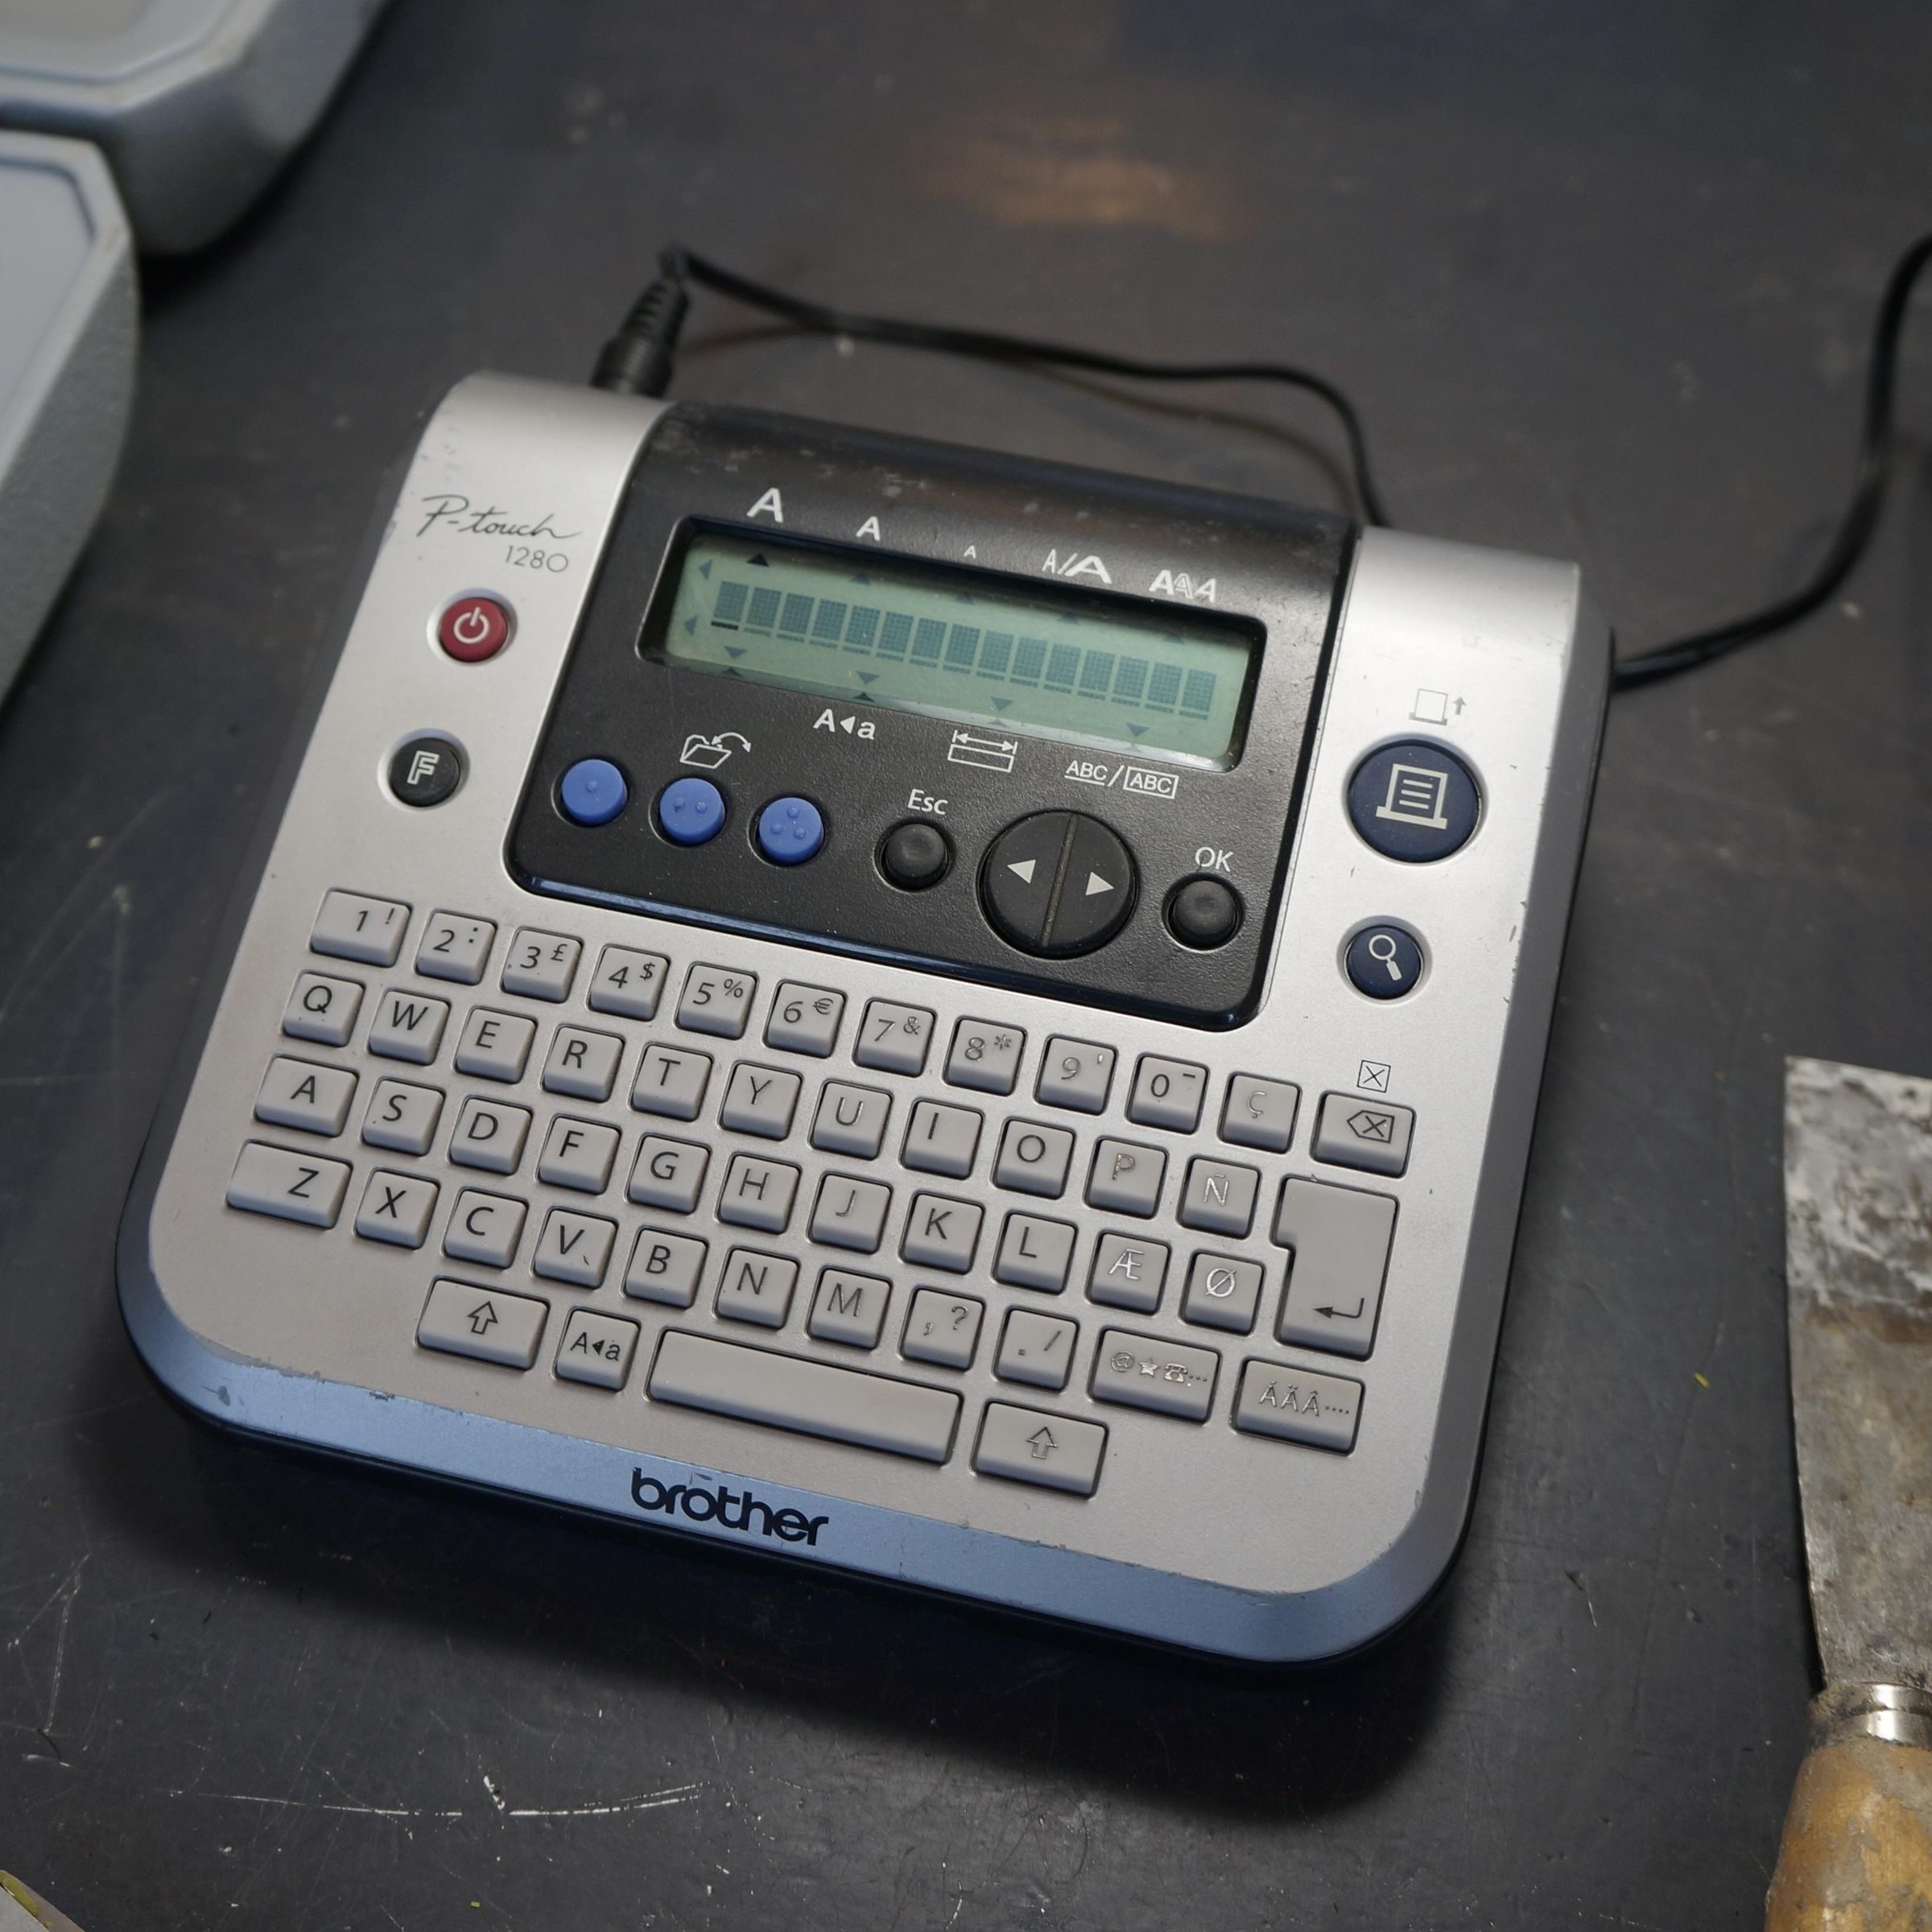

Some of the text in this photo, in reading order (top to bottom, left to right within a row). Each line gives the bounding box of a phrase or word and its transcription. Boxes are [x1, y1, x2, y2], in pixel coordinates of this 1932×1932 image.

[416, 494, 582, 539] P-touch
[746, 487, 784, 523] A
[856, 516, 881, 541] A
[506, 545, 568, 572] 1280
[964, 545, 976, 559] A
[407, 750, 440, 785] F
[907, 788, 948, 815] Esc
[1195, 846, 1234, 872] OK
[303, 985, 332, 1014] Q
[391, 1000, 429, 1031] W
[475, 1020, 501, 1049] E
[563, 1039, 588, 1069] R
[658, 1057, 681, 1087] T
[290, 1075, 316, 1104] A
[749, 1075, 773, 1105] Y
[382, 1094, 407, 1122] S
[836, 1096, 864, 1126] U
[1248, 1091, 1268, 1119] Ç
[467, 1112, 499, 1141] D
[927, 1112, 939, 1141] I
[559, 1129, 584, 1158] F
[1017, 1134, 1046, 1163] O
[650, 1151, 679, 1181] G
[1113, 1153, 1136, 1181] P
[287, 1167, 320, 1199] Z
[738, 1168, 770, 1201] H
[1203, 1172, 1230, 1206] Ñ
[374, 1186, 407, 1219] X
[835, 1189, 857, 1217] J
[465, 1206, 495, 1236] C
[924, 1208, 953, 1241] K
[559, 1224, 585, 1255] V
[1018, 1226, 1038, 1259] L
[645, 1244, 671, 1275] B
[1108, 1249, 1145, 1281] Æ
[736, 1262, 768, 1295] N
[1205, 1267, 1237, 1298] Ø
[827, 1282, 863, 1318] M
[631, 1467, 829, 1546] brother
